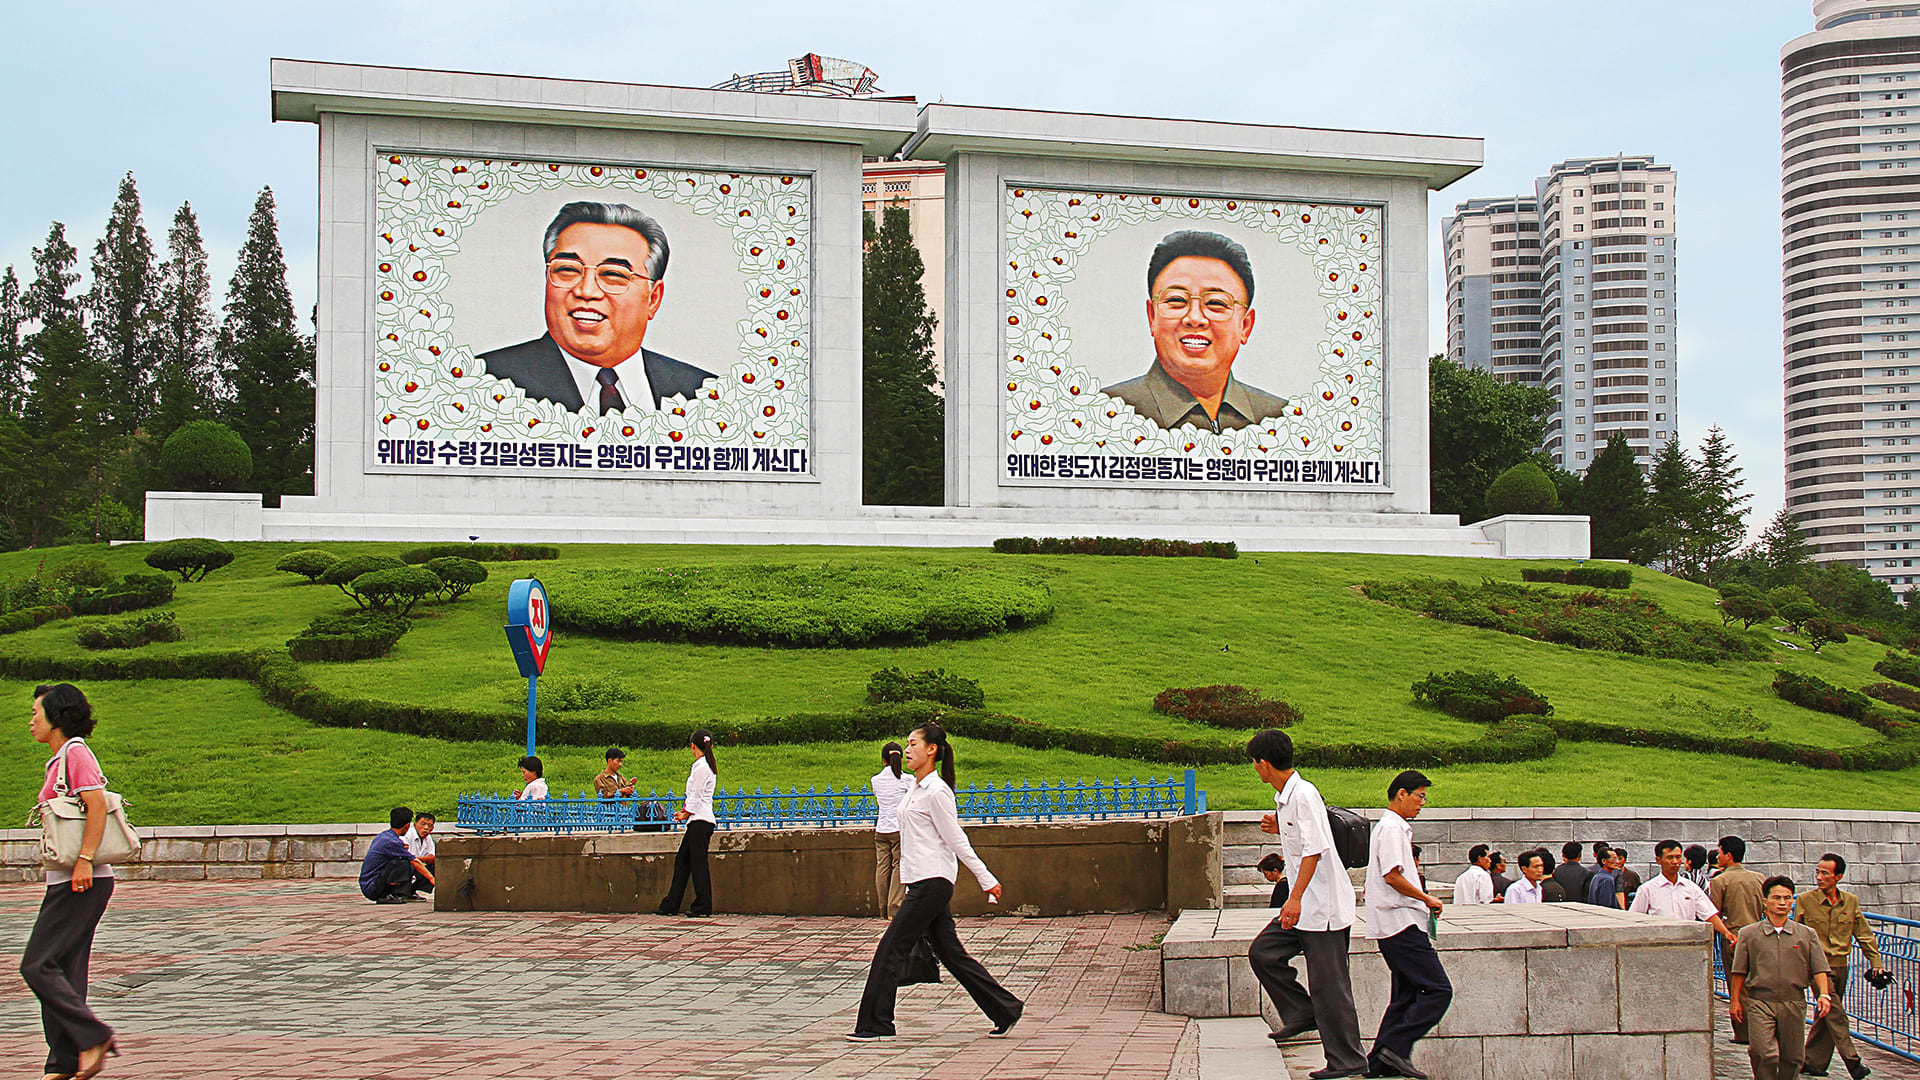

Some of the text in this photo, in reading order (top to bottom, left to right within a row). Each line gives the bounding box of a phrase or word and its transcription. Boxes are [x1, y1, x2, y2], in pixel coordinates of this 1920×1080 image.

[378, 439, 808, 472] 위대한 수령 김일성동지는 영원히 우리와 함께 계신다
[1007, 454, 1380, 483] 위대한 령도자 김정일동지는 영원히 우리와 함께 계신다
[531, 598, 544, 629] 지
